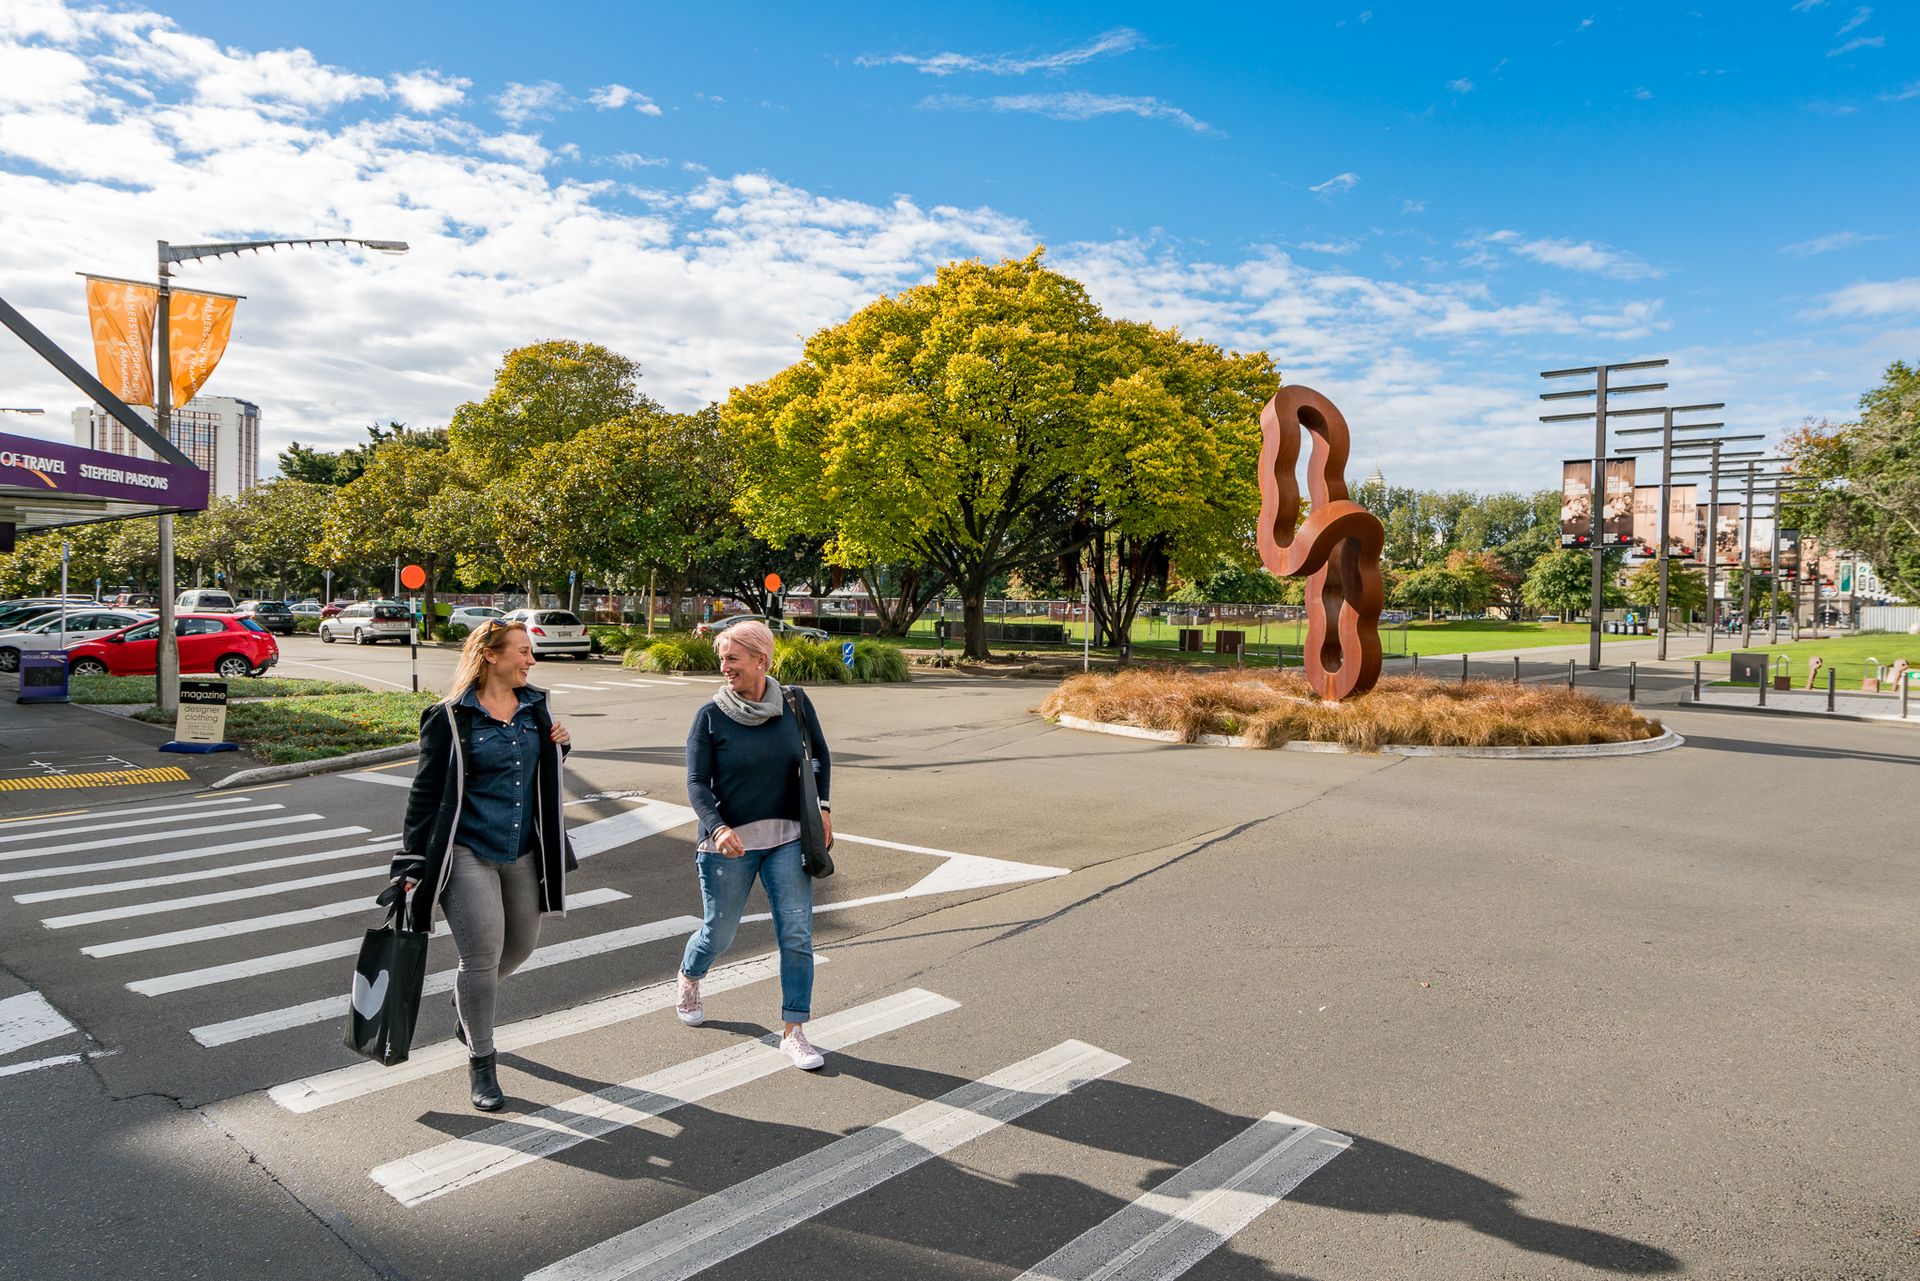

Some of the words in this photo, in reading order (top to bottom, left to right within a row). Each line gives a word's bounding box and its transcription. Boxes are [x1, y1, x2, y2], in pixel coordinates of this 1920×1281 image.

[126, 287, 139, 348] PALMERSTON
[0, 451, 21, 467] OF
[23, 454, 67, 475] TRAVEL
[79, 464, 124, 484] STEPHEN
[125, 472, 169, 490] PARSONS
[181, 691, 225, 700] magazine
[184, 705, 220, 714] designer
[184, 714, 219, 723] clothing
